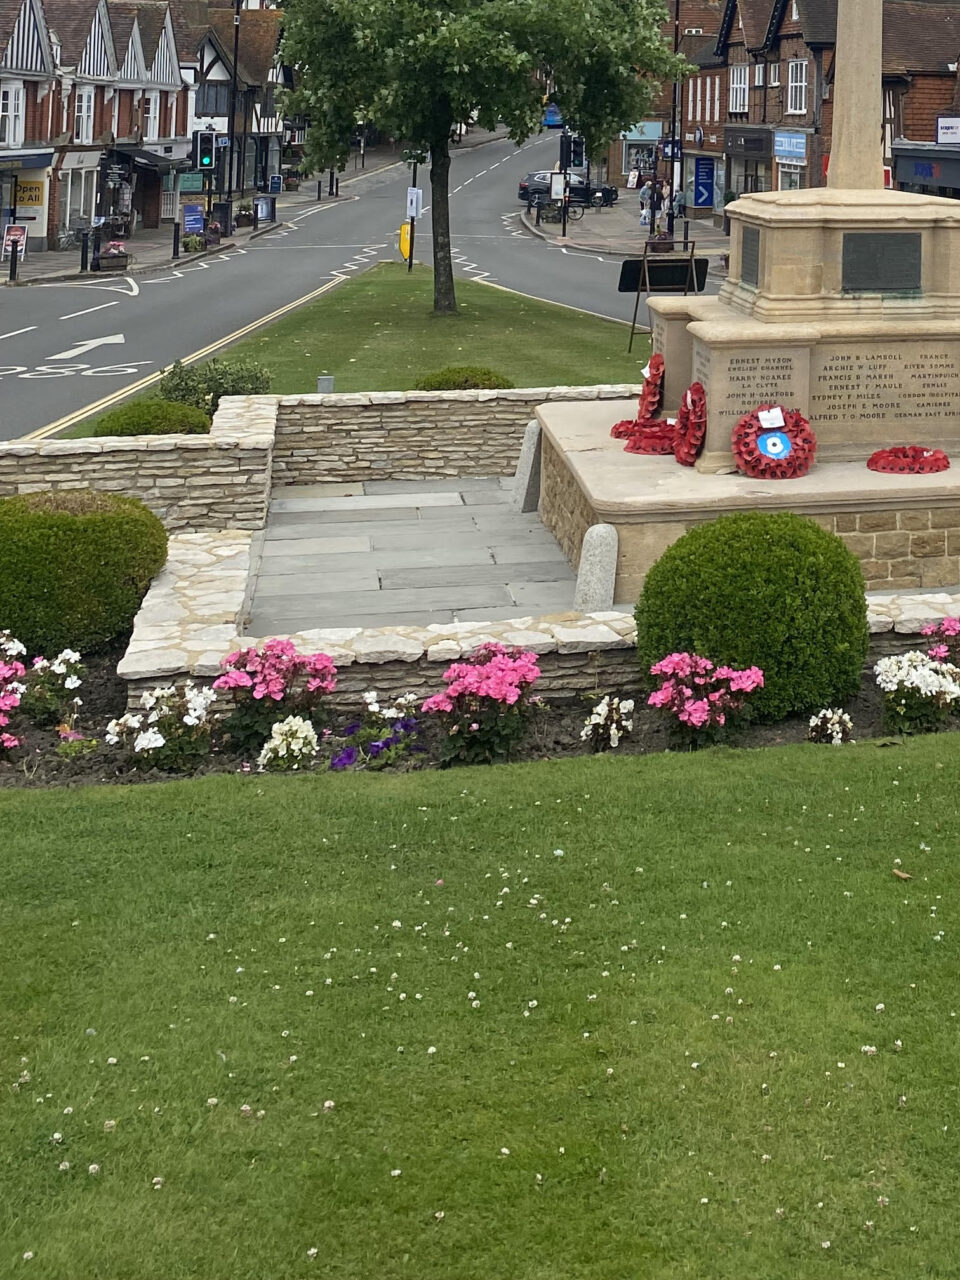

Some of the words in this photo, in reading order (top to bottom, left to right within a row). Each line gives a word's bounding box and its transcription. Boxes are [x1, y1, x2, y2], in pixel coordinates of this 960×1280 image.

[16, 184, 40, 194] Open
[27, 194, 40, 202] All
[818, 374, 852, 382] FRANCIS
[860, 412, 886, 420] MOORE
